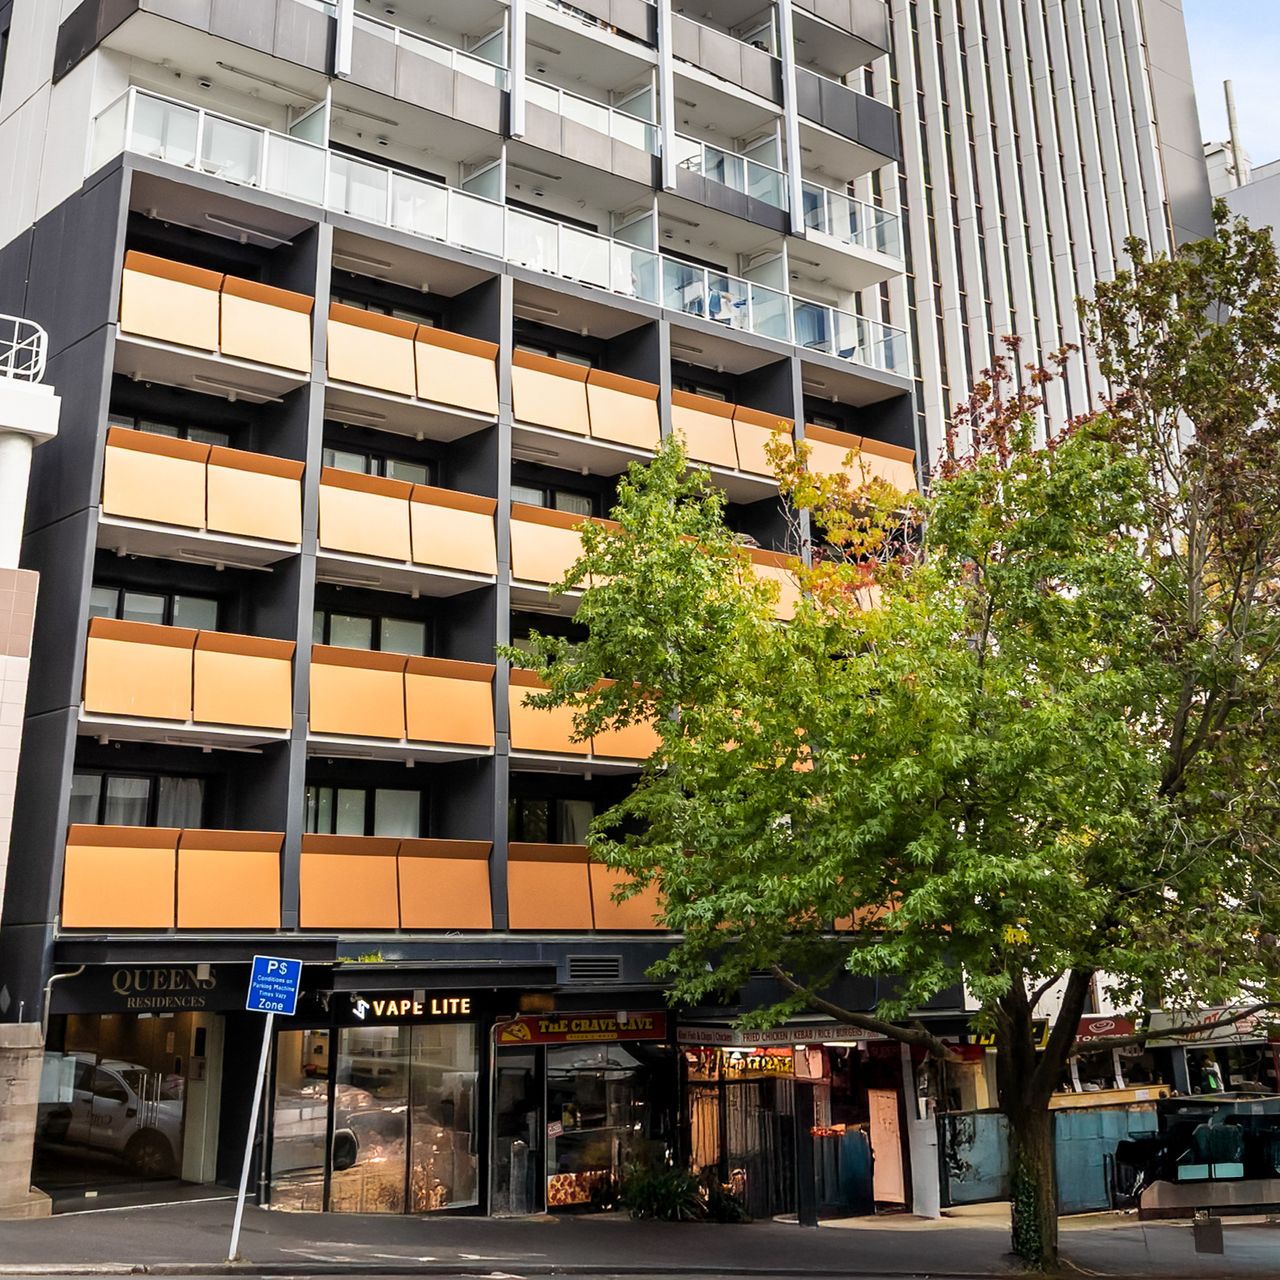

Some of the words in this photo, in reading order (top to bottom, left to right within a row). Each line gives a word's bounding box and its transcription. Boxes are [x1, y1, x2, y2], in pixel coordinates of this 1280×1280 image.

[112, 968, 217, 995] QUEENS
[257, 974, 285, 983] Conditions
[253, 981, 272, 990] Parking
[273, 984, 295, 992] Machine
[127, 995, 206, 1008] RESIDENCES
[258, 998, 284, 1011] Zone
[372, 999, 424, 1016] VAPE
[431, 998, 471, 1015] LITE
[538, 1020, 568, 1033] THE
[571, 1018, 616, 1032] CRAVE
[620, 1017, 653, 1030] CAVE
[742, 1032, 759, 1041] FRIED
[761, 1031, 788, 1041] CHICKEN
[794, 1029, 813, 1039] KEBAB
[817, 1029, 831, 1039] RICE
[836, 1027, 862, 1037] BURGERS
